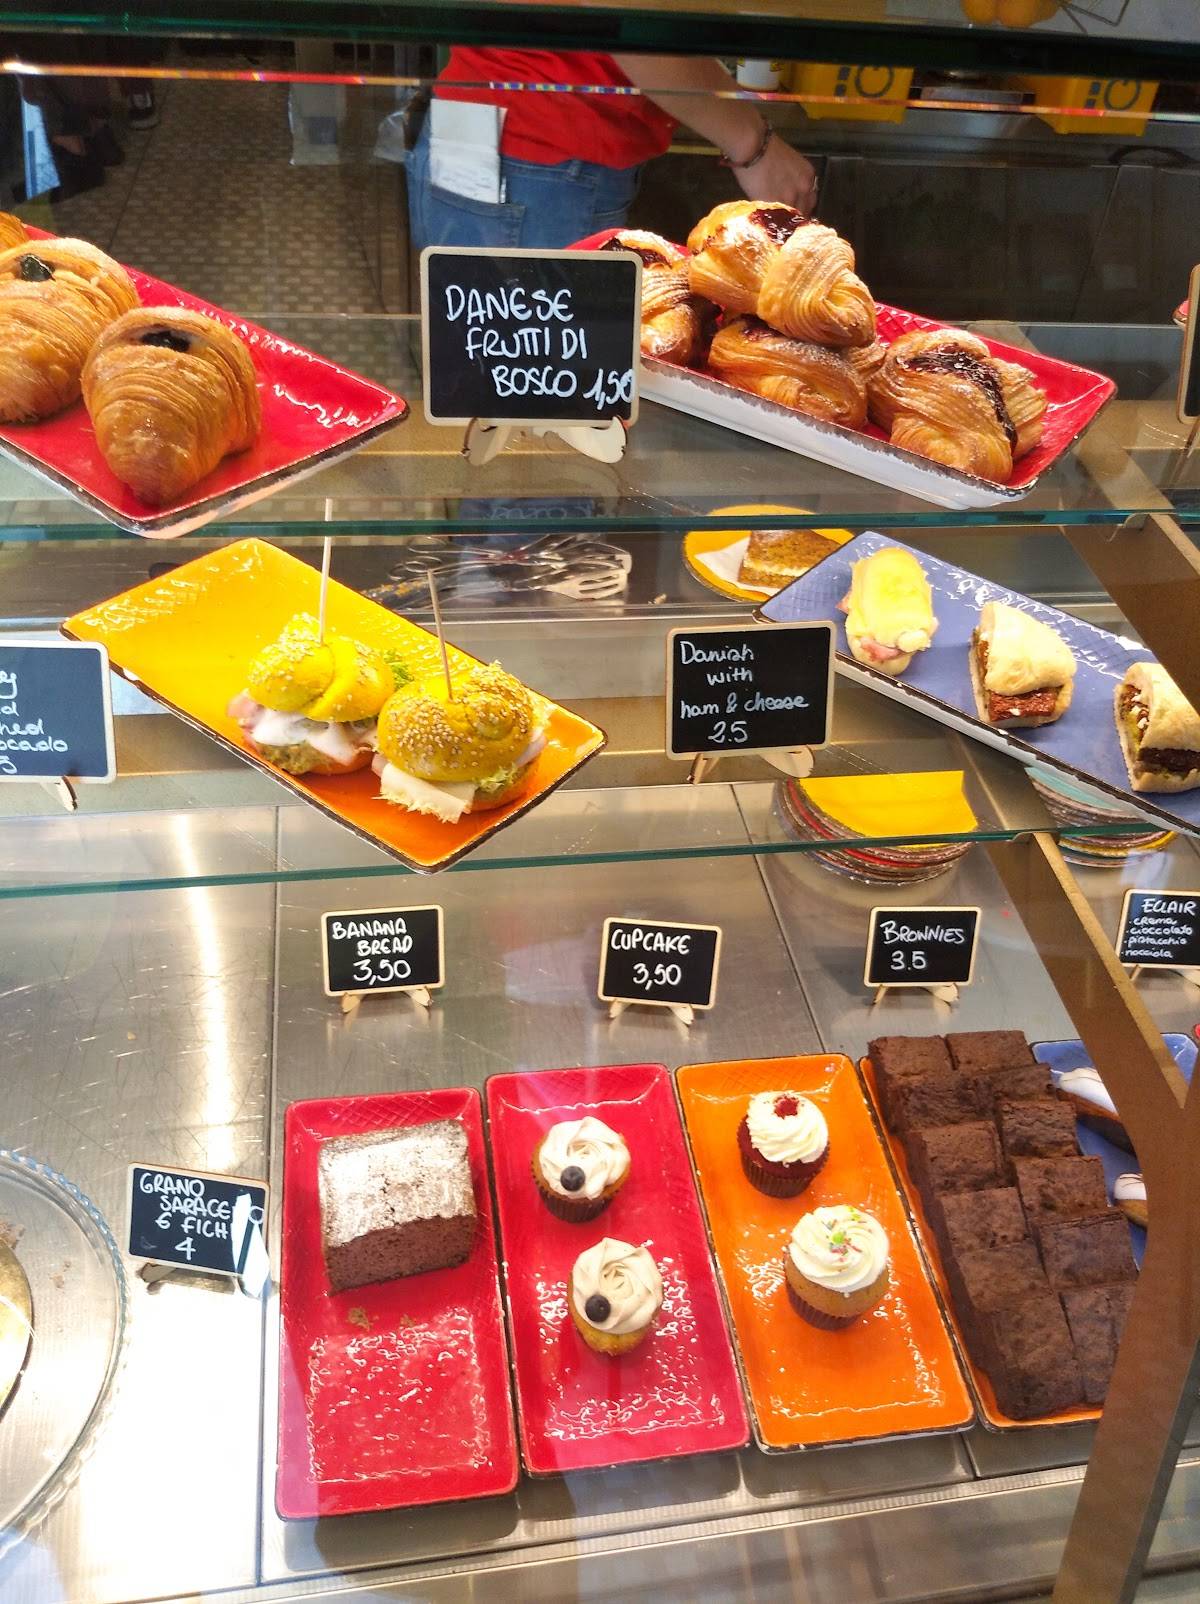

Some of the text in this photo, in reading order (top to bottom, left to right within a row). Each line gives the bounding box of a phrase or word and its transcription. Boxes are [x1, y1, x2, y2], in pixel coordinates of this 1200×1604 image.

[445, 284, 574, 325] DANESE
[465, 327, 588, 360] FRUTTI DI
[491, 365, 633, 410] BOSCO 1,50
[680, 640, 754, 664] Danish
[706, 666, 753, 686] with
[680, 692, 809, 719] ham & cheese
[708, 721, 748, 743] 2.5
[1141, 898, 1197, 916] ECLAIR
[332, 917, 407, 939] BANANA
[880, 920, 965, 944] BROWNIES
[1129, 925, 1193, 935] cioccolato
[357, 935, 413, 956] BREAD
[611, 928, 691, 955] CUPCAKE
[1125, 948, 1173, 958] nocciola
[1127, 936, 1187, 948] pistacchio
[353, 958, 412, 985] 3,50
[890, 950, 927, 970] 3.5
[632, 962, 682, 991] 3,50
[140, 1172, 205, 1197] GRANO
[181, 1216, 235, 1240] FICH
[174, 1236, 196, 1261] 4
